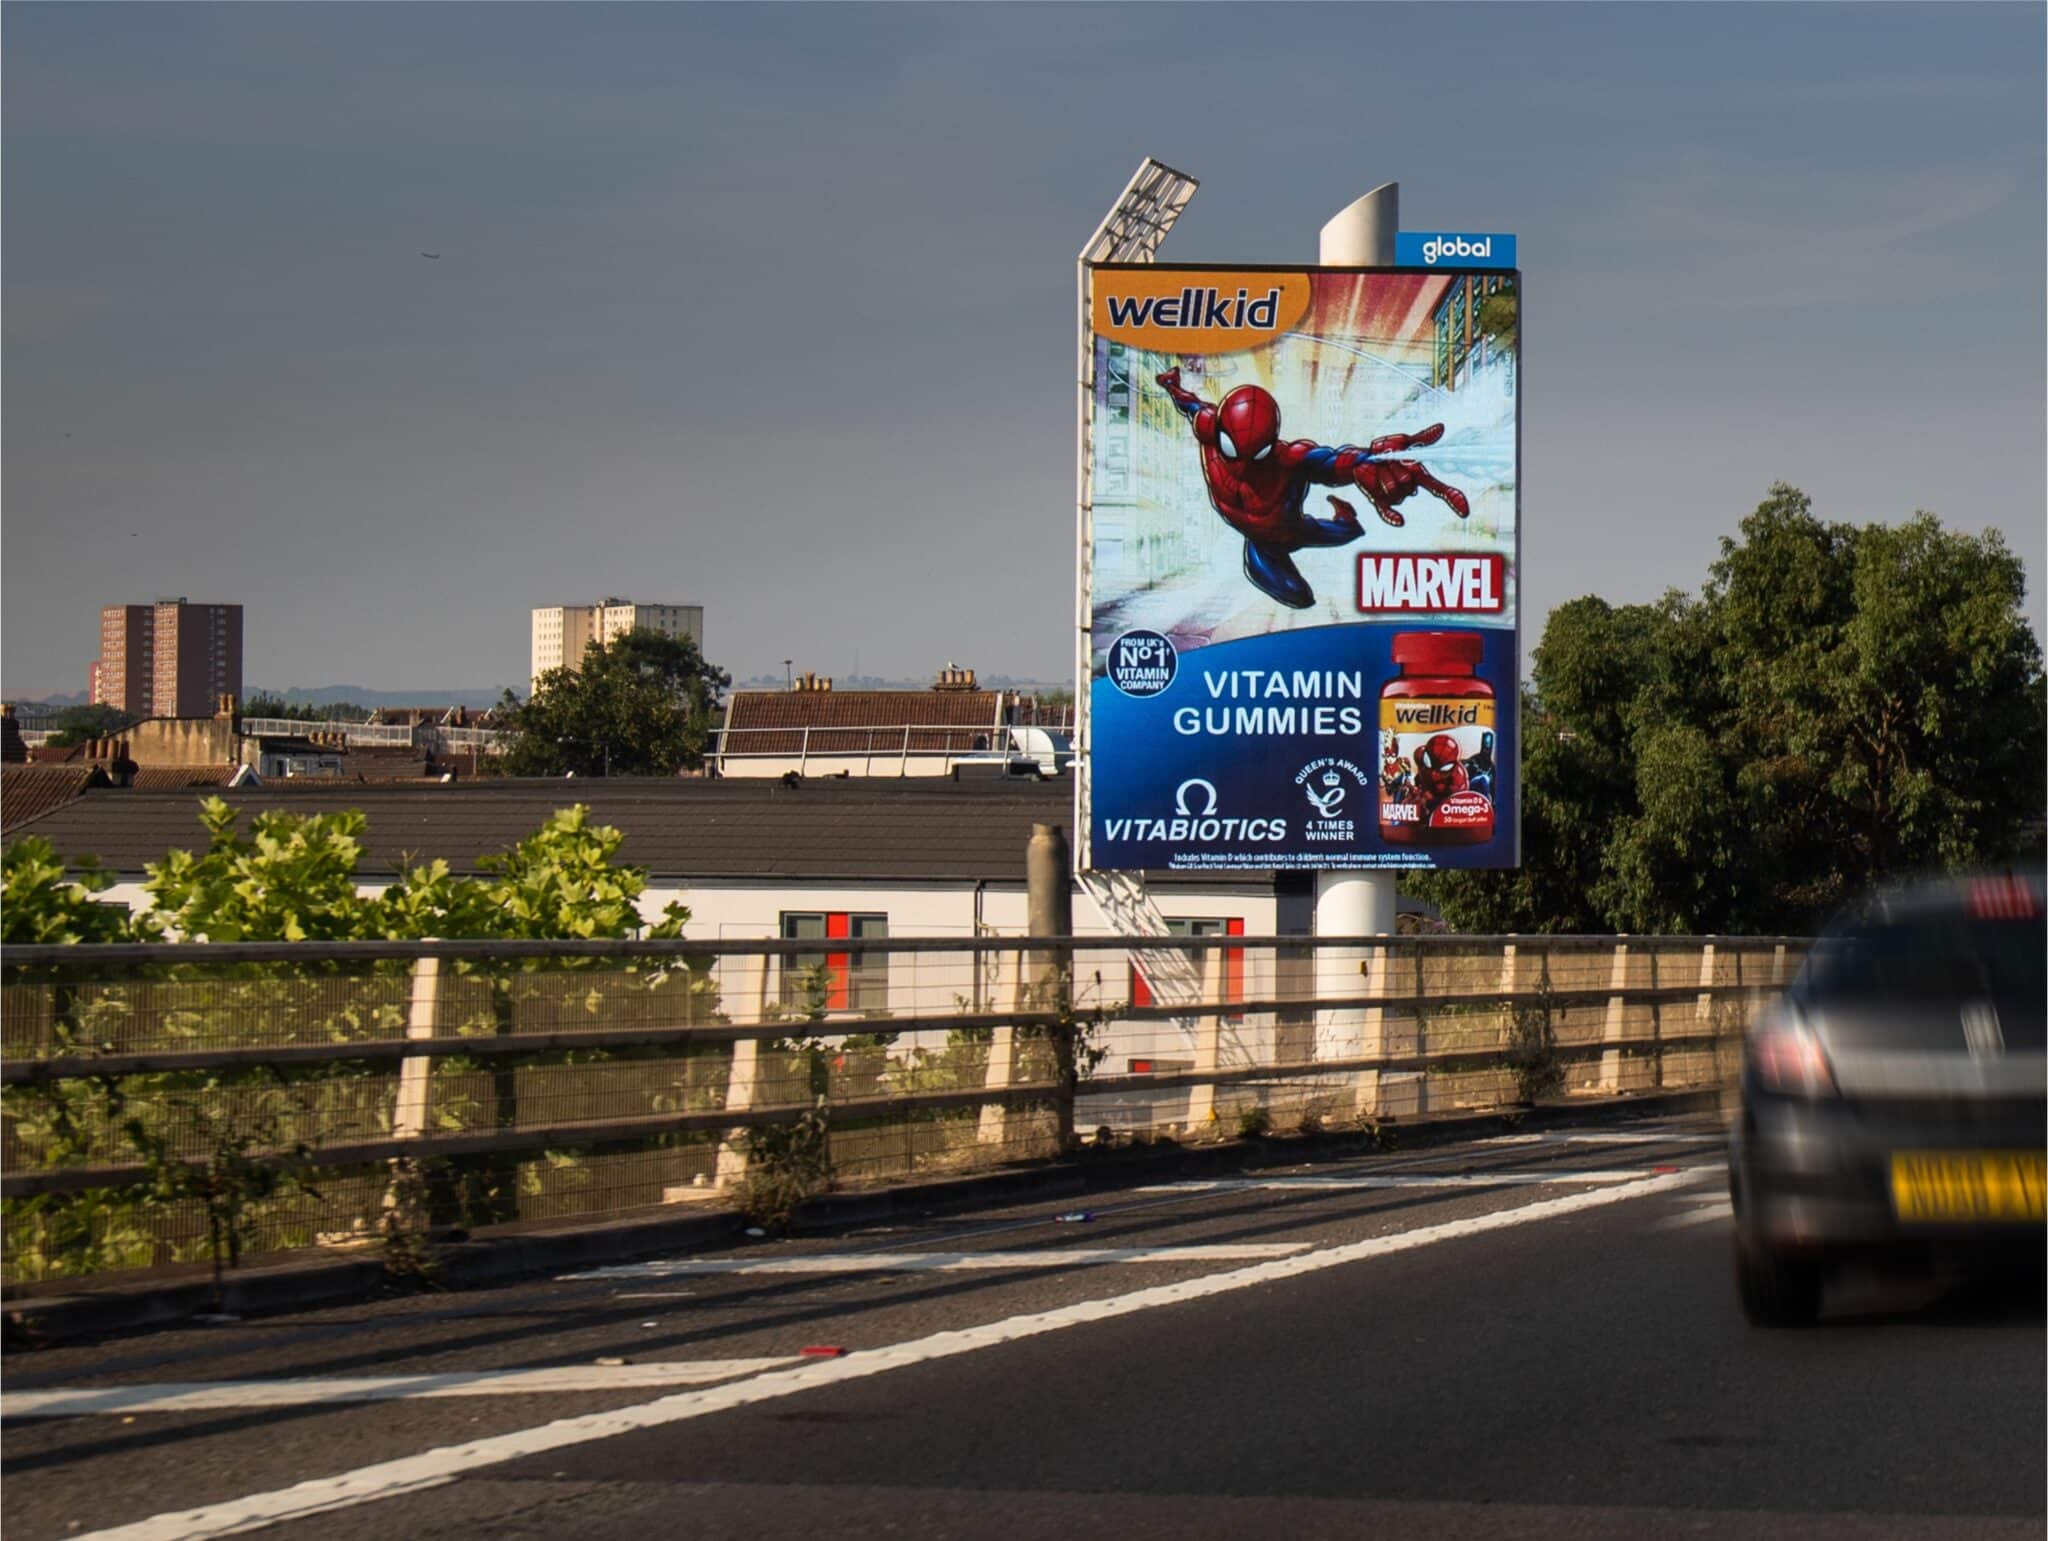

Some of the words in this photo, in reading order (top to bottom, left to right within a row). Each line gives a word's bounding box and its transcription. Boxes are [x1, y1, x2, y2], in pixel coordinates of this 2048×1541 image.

[1423, 236, 1490, 264] global
[1108, 287, 1280, 329] wellkid
[1362, 558, 1499, 608] MARVEL
[1120, 638, 1144, 647] FROM
[1116, 668, 1169, 680] VITAMIN
[1120, 680, 1165, 690] COMPANY
[1204, 671, 1361, 698] VITAMIN
[1173, 707, 1362, 735] GUMMIES
[1396, 704, 1478, 724] wellkid
[1295, 758, 1335, 784] QUEEN'S
[1336, 759, 1368, 786] AWARD
[1383, 803, 1420, 821] MARVEL
[1441, 803, 1489, 816] Omega-3
[1105, 819, 1286, 841] VITABIOTICS
[1306, 820, 1313, 829] 4
[1317, 820, 1354, 829] TIMES
[1305, 831, 1354, 841] WINNER
